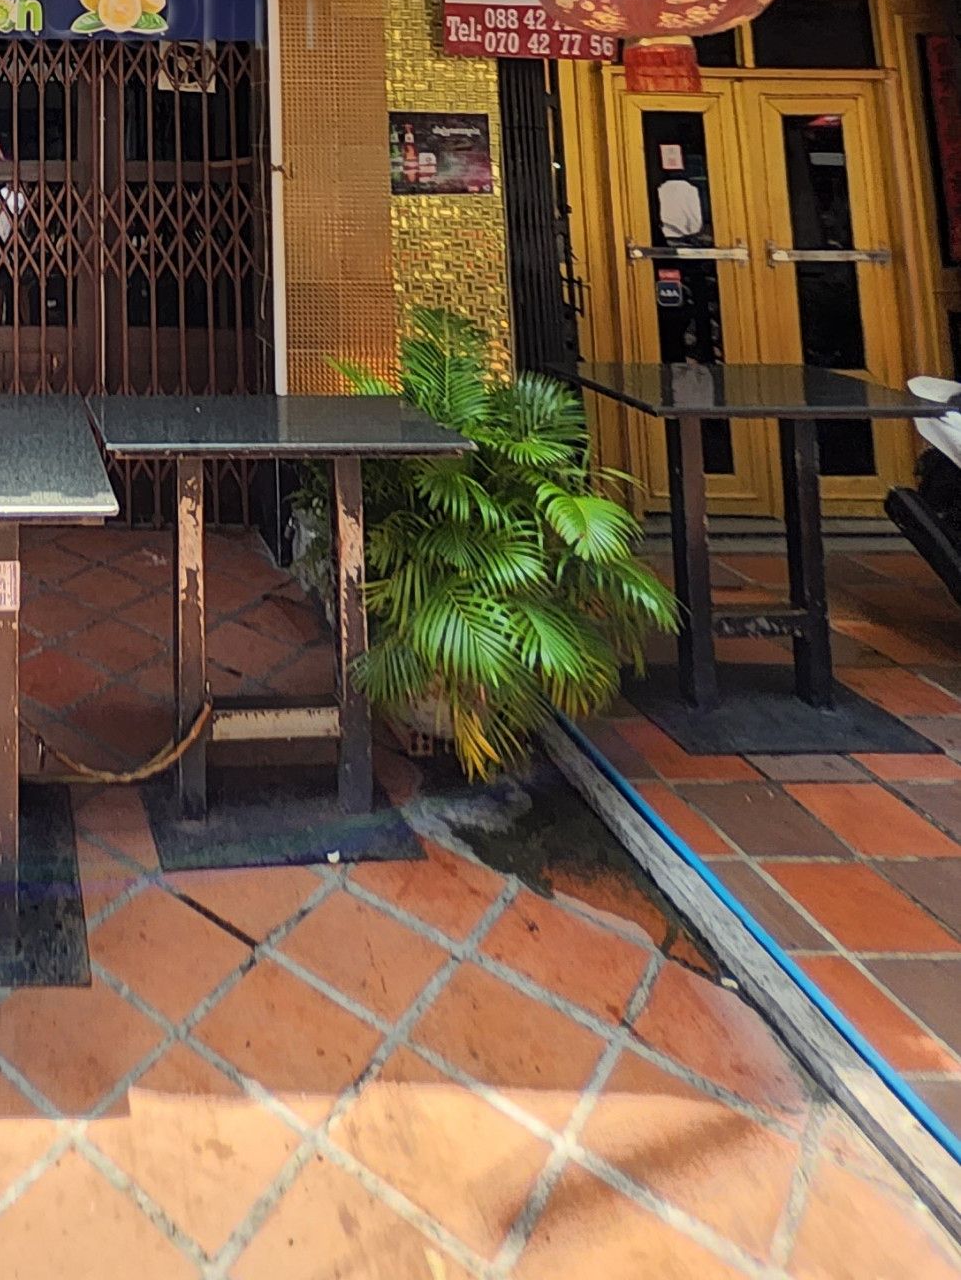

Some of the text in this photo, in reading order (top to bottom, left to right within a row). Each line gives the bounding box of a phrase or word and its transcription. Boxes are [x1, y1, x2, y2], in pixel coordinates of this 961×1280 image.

[446, 15, 482, 43] Tel:
[484, 7, 519, 29] 088
[523, 9, 547, 30] 42
[484, 31, 614, 56] 070 42 77 56
